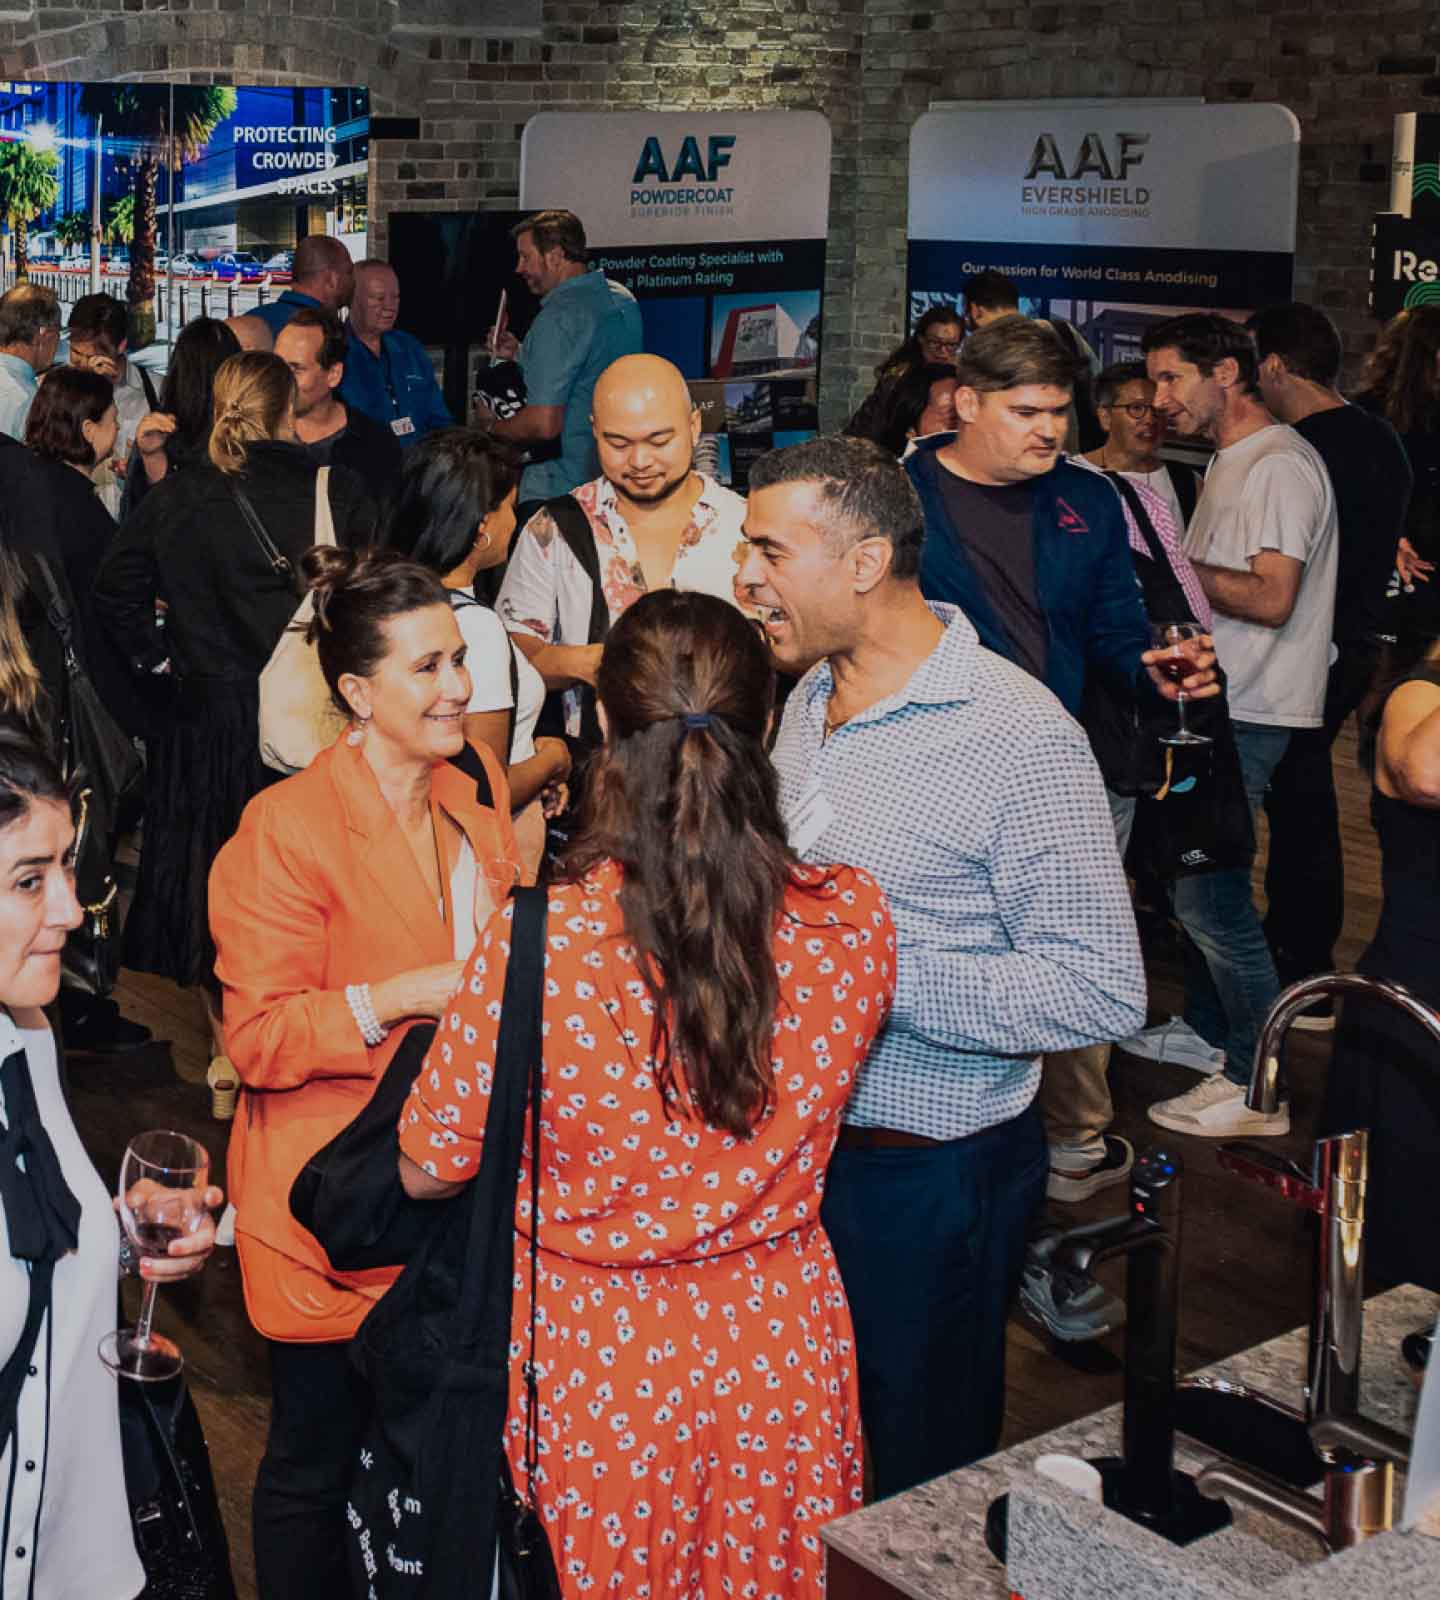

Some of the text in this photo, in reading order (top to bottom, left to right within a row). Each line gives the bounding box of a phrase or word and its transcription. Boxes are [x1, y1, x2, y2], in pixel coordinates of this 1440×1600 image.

[233, 126, 337, 143] PROTECTING
[252, 152, 337, 169] CROWDED
[632, 135, 736, 183] AAF
[1023, 133, 1151, 180] AAF
[277, 178, 337, 195] SPACES
[1021, 186, 1150, 205] EVERSHIELD
[630, 187, 735, 206] POWDERCOAT
[600, 256, 647, 270] Powder
[649, 255, 696, 270] Coating
[699, 251, 755, 269] Specialist
[757, 248, 785, 263] with
[637, 272, 692, 288] Platinum
[695, 271, 735, 287] Rating
[1041, 265, 1058, 278] for
[1061, 264, 1102, 280] World
[1105, 266, 1141, 281] Class
[1144, 269, 1217, 288] Anodising
